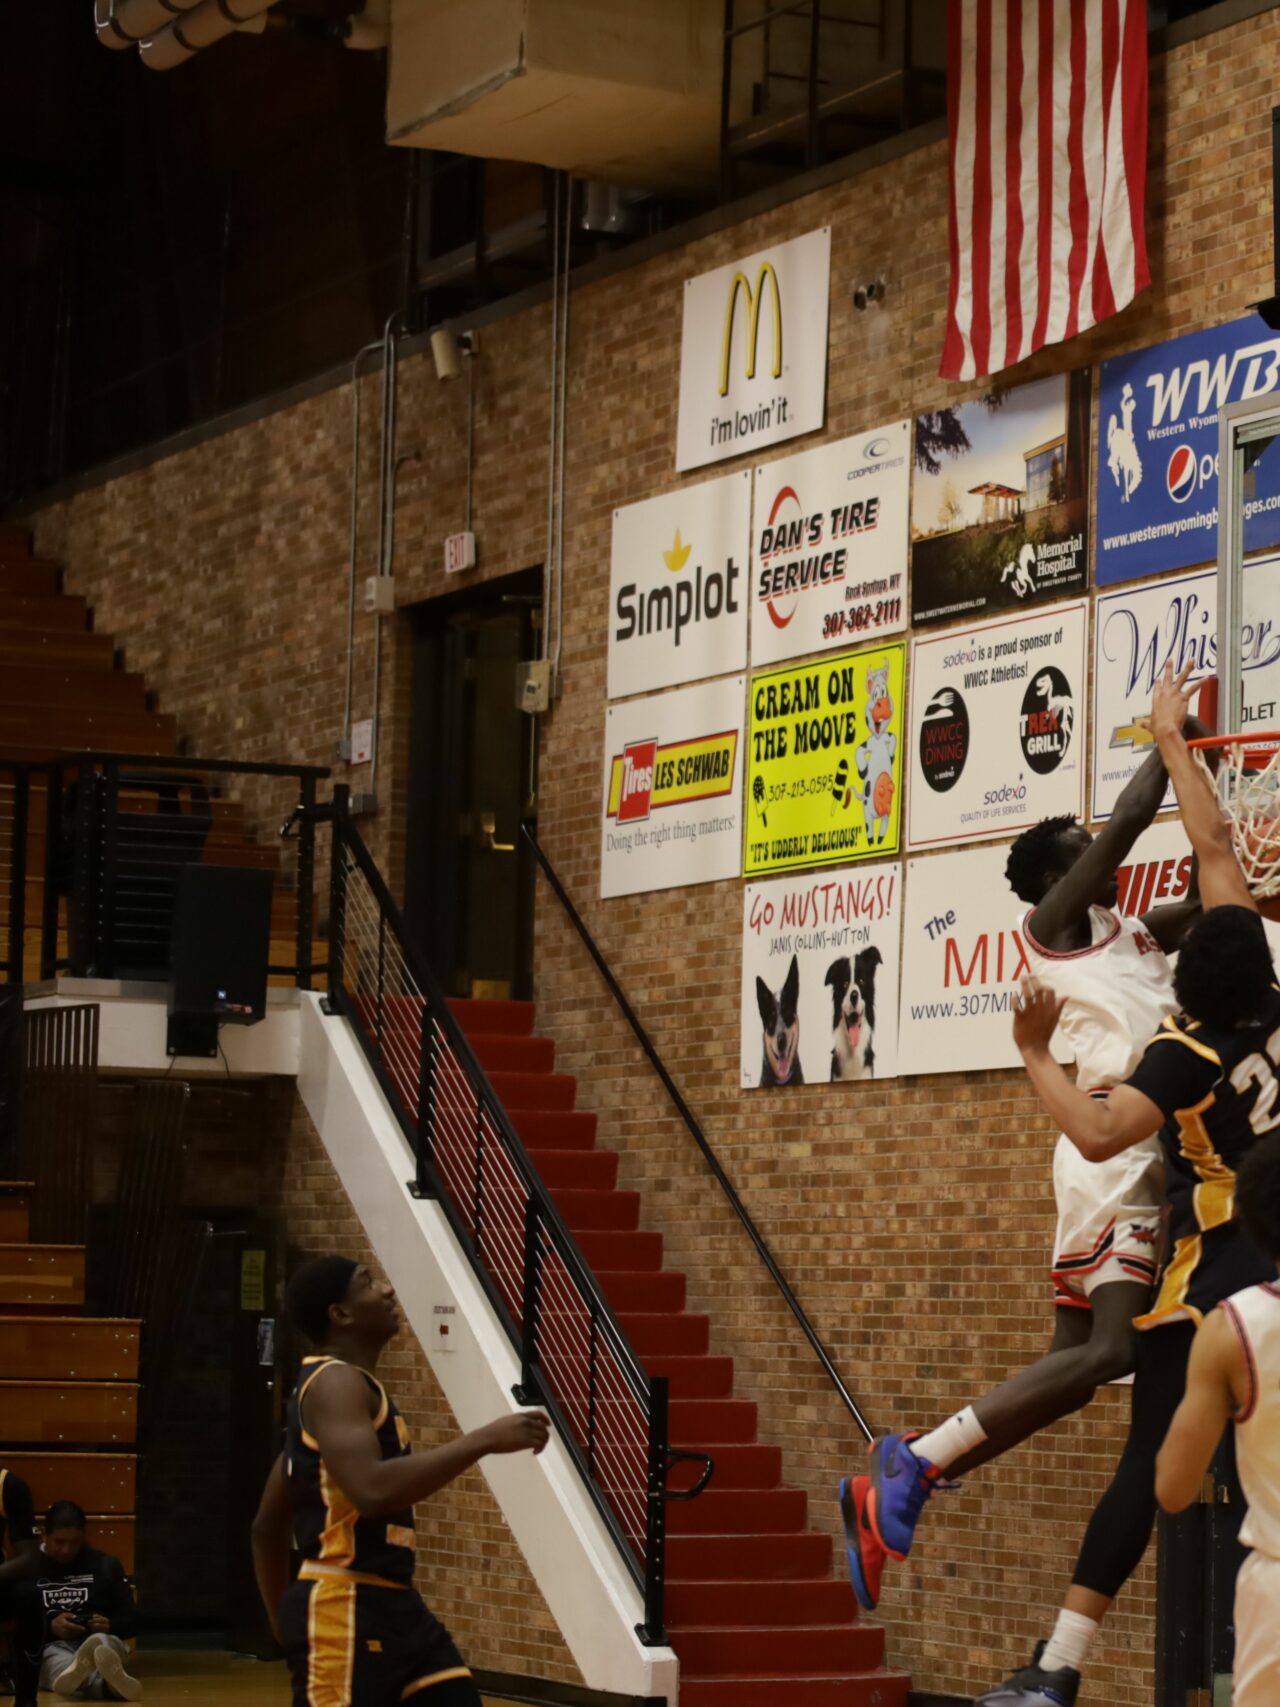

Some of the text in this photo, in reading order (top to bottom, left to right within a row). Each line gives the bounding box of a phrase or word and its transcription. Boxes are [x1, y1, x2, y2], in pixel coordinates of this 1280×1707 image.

[710, 397, 788, 446] i'm lovin' it
[1147, 423, 1186, 441] Western
[760, 497, 880, 560] DAN'S TIRE
[1037, 534, 1083, 561] Memorial
[758, 549, 849, 602] SERVICE
[1037, 553, 1077, 578] Hospital
[616, 557, 740, 647] Simplot
[822, 597, 903, 640] 307-362-2111
[943, 627, 1063, 669] sodexo is a proud sponsor of
[964, 660, 1029, 690] WWCC Athletics!
[754, 666, 855, 722] CREAM ON
[753, 711, 857, 763] THE MOOVE
[926, 722, 964, 744] WWCC
[1026, 733, 1062, 757] GRILL
[654, 748, 731, 791] LES SCHWAB
[925, 742, 964, 766] DINING
[623, 755, 653, 802] Tires
[768, 773, 835, 804] 307-213-0595
[983, 783, 1027, 806] sodexo
[961, 803, 1027, 824] QUALITY OF LIFE SERVICES
[606, 820, 697, 854] Doing the right thing
[770, 833, 810, 861] UDDERLY
[750, 874, 896, 936] GO MUSTANGS!
[923, 909, 957, 942] The
[769, 928, 793, 957] JANIS
[943, 929, 1032, 990] MIX
[48, 1591, 83, 1599] RAIDERS
